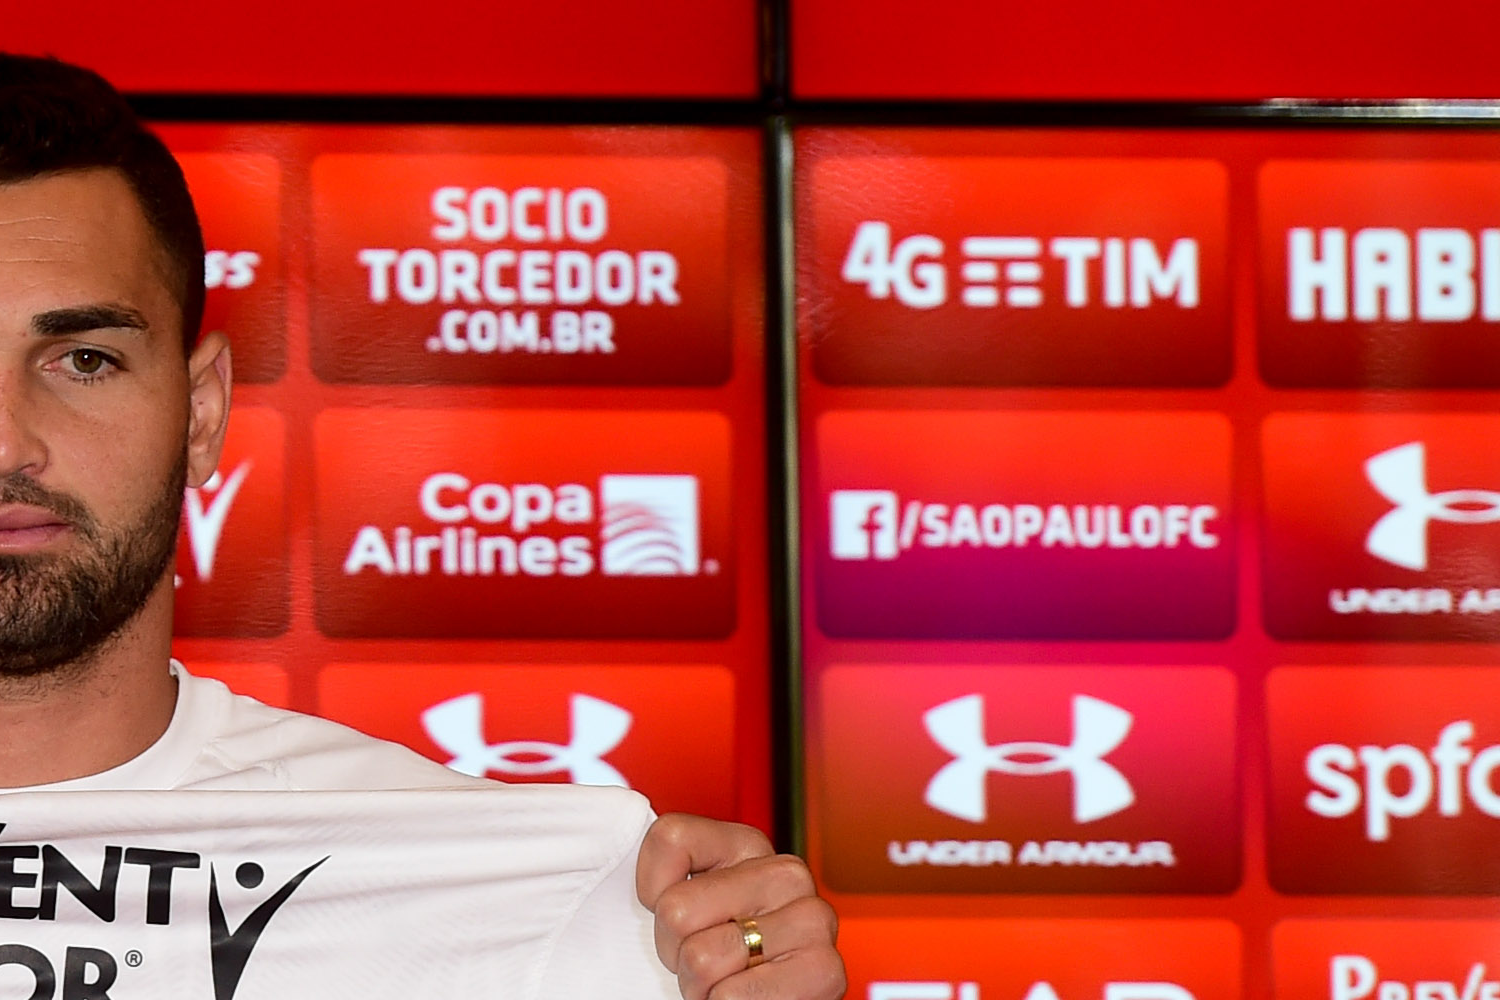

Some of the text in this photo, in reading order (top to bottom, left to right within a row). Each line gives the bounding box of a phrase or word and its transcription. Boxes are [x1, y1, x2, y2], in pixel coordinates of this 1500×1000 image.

[431, 186, 608, 243] SOCIO
[358, 249, 679, 305] TORCEDOR
[843, 221, 1198, 309] 4G TIM
[427, 310, 614, 353] .COM.BR
[420, 473, 593, 532] Copa
[902, 501, 1217, 548] /SAOPAULOFC
[346, 527, 593, 576] Airlines
[1331, 589, 1453, 613] UNDER
[889, 841, 1174, 866] UNDER ARMOUR
